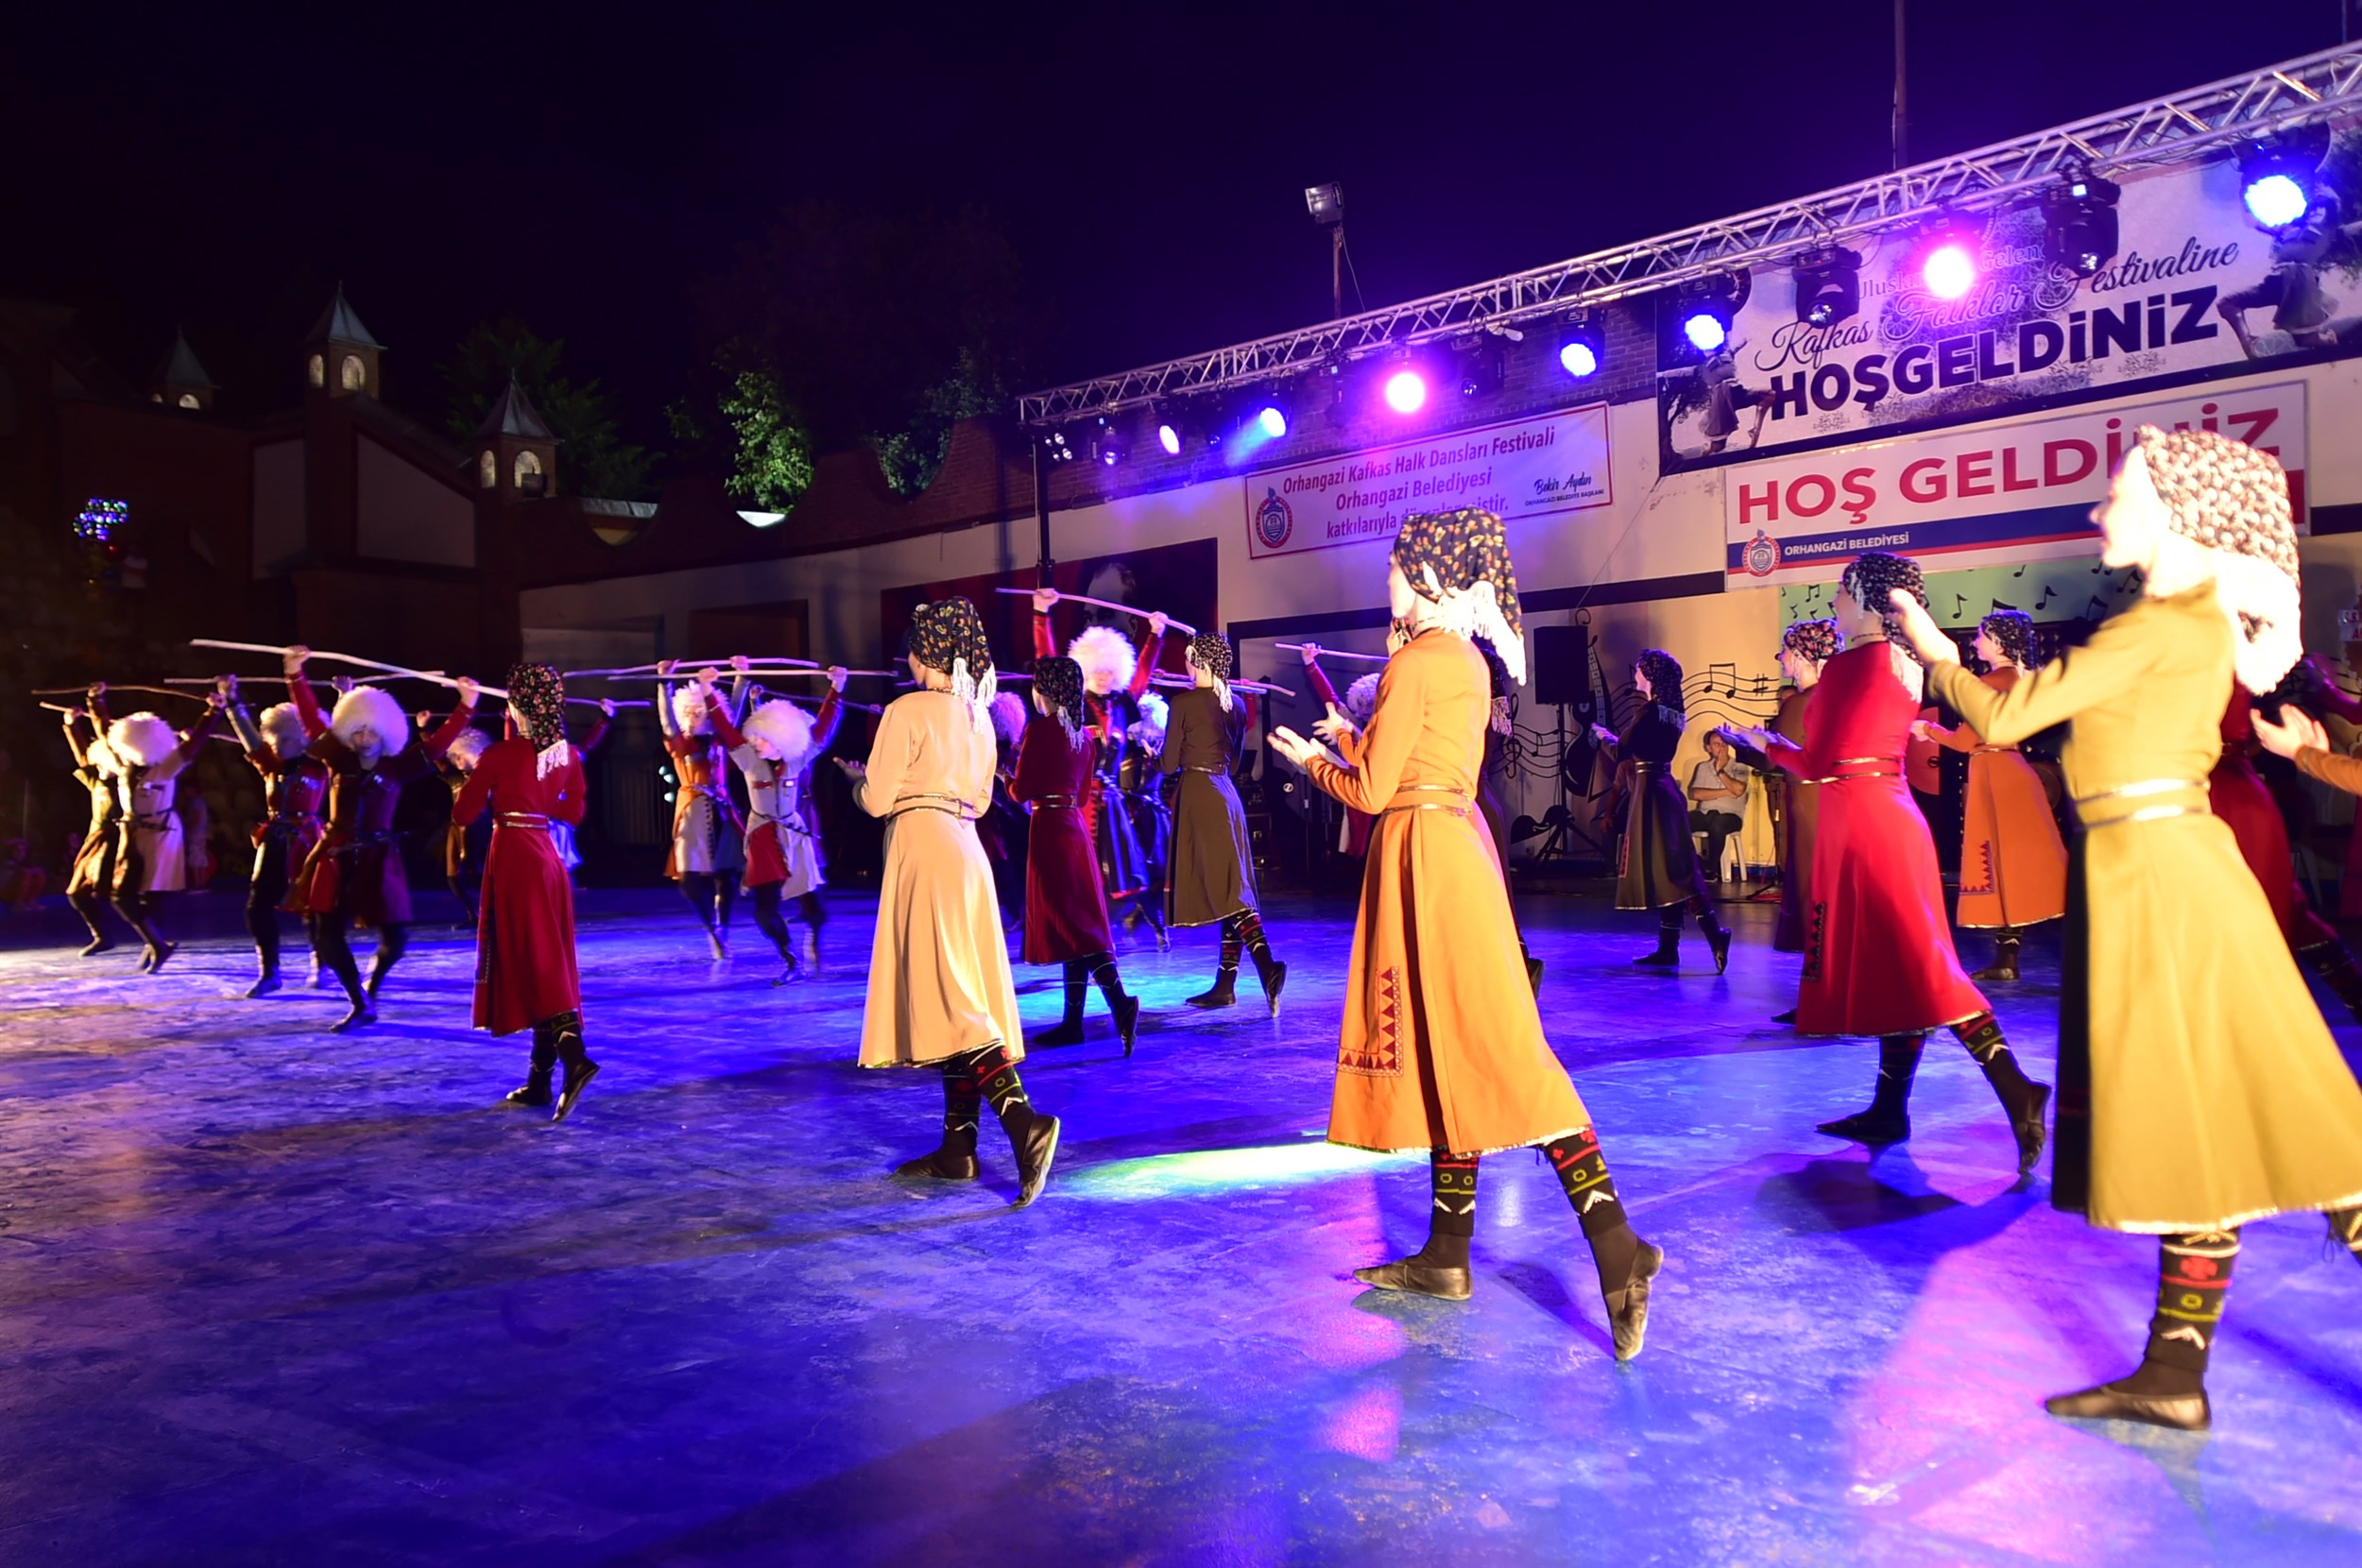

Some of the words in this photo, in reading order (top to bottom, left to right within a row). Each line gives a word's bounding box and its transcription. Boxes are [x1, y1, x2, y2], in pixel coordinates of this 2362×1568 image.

[1754, 320, 1874, 370] Kafkas
[1882, 279, 2025, 342] Folklor
[2034, 236, 2239, 311] Festivaline
[1283, 467, 1345, 495] Orhangazi
[1348, 459, 1392, 484] Kafkas
[1395, 449, 1426, 474] Halk
[1429, 442, 1489, 469] Dansları
[1492, 425, 1555, 455] Festivali
[1336, 481, 1409, 511] Orhangazi
[1412, 467, 1493, 497] Belediyesi
[1738, 467, 1877, 525] HOŞ
[1326, 511, 1397, 540] katkılarıyla
[1784, 537, 1848, 556] ORHANGAZİ
[1849, 531, 1909, 550] BELEDİYESİ
